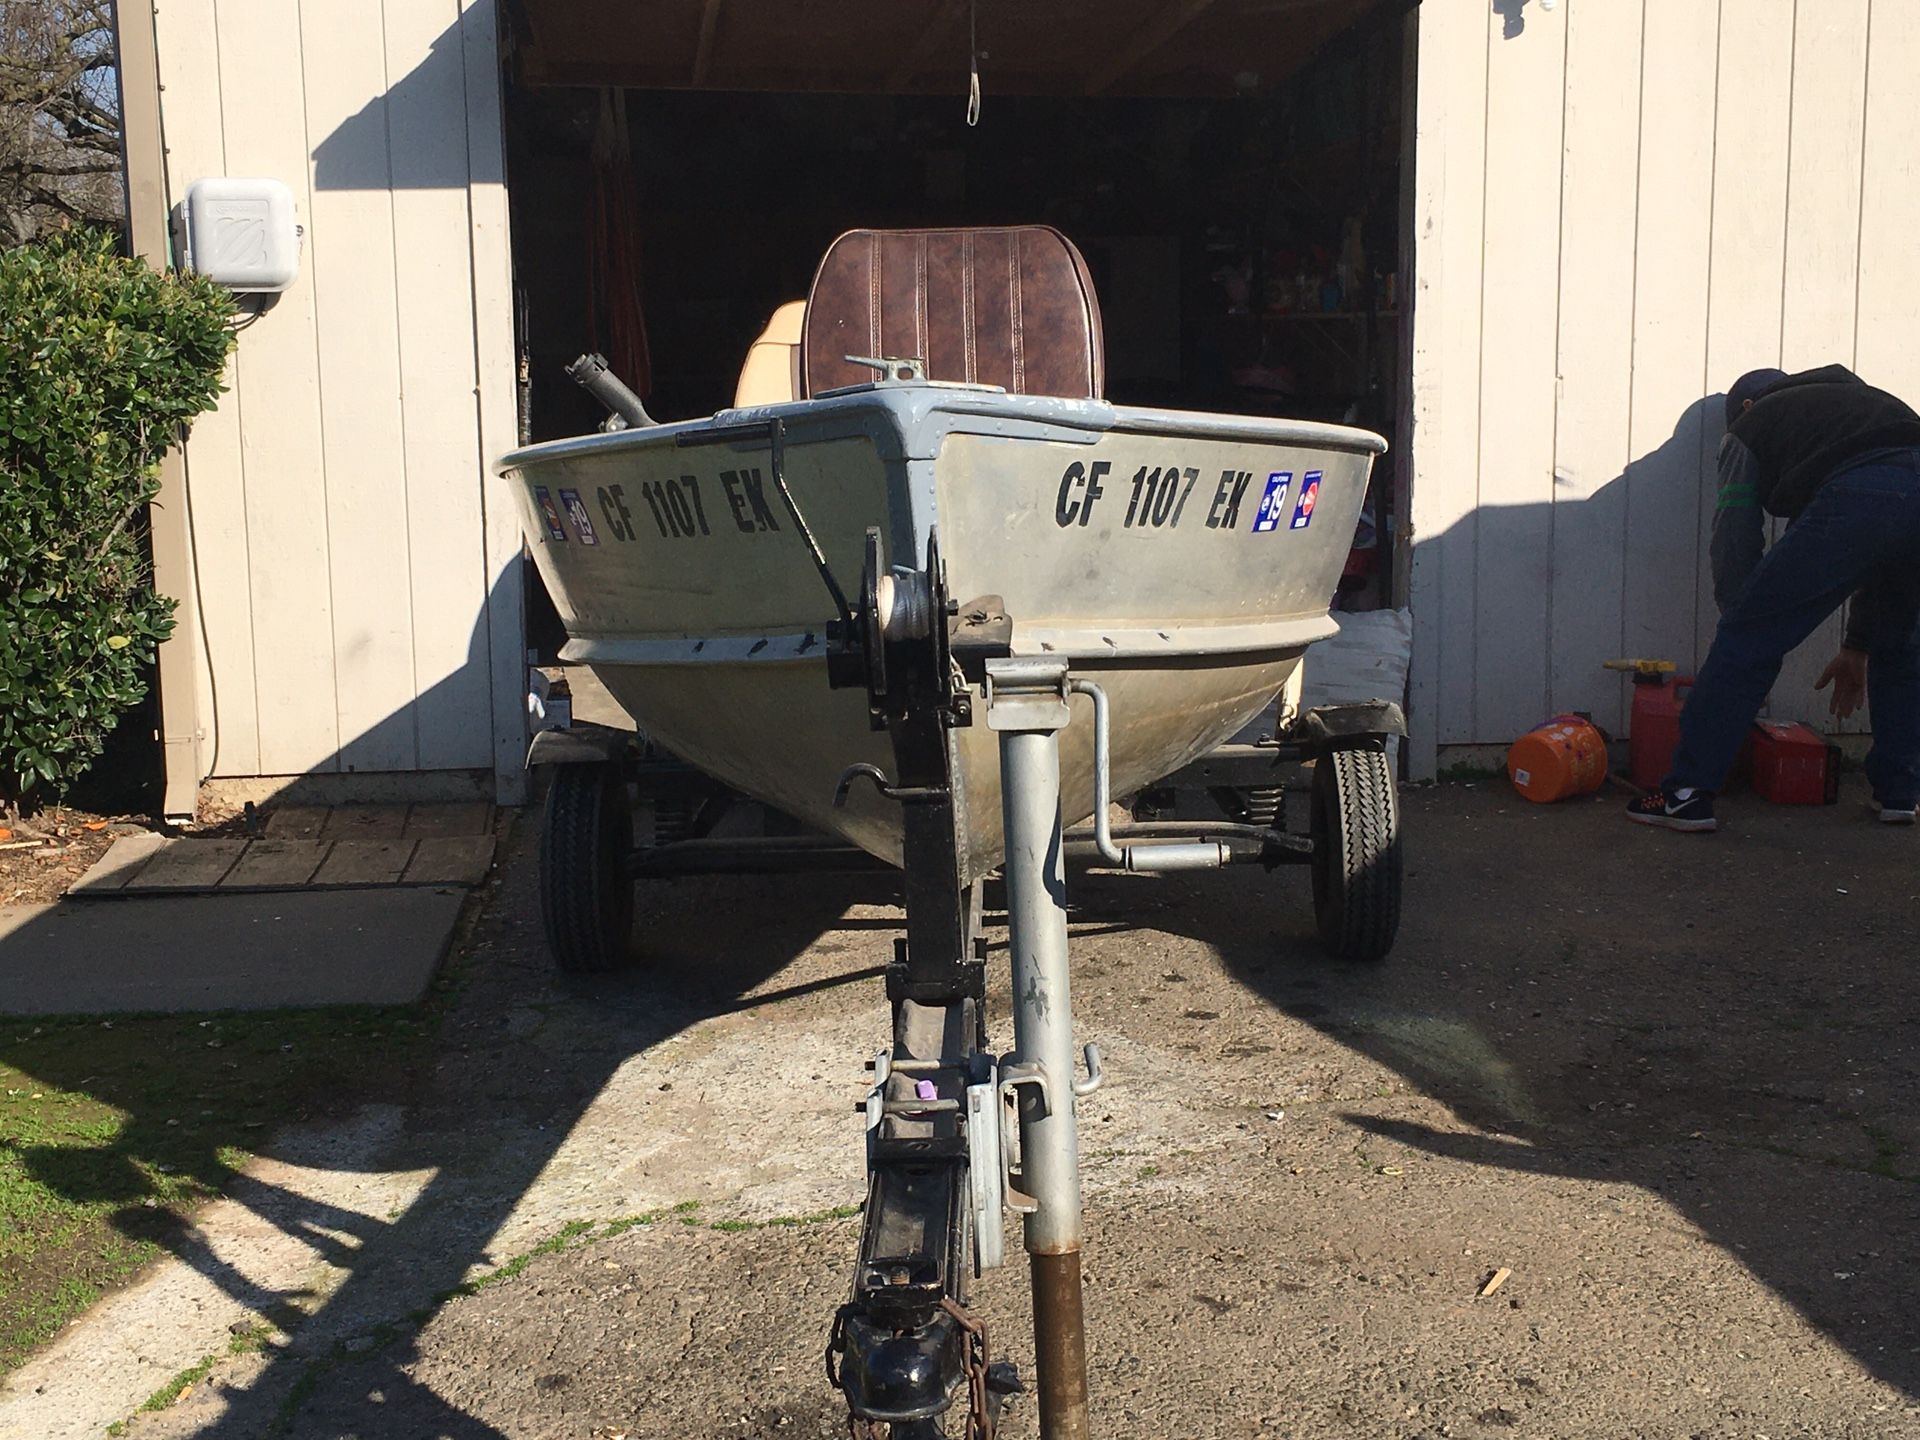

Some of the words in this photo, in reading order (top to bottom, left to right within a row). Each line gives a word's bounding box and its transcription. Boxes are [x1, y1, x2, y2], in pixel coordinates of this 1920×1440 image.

[597, 484, 636, 541] CF
[642, 475, 710, 537] 1107
[1055, 461, 1112, 528] CF
[1124, 466, 1200, 528] 1107
[1267, 484, 1288, 520] 19
